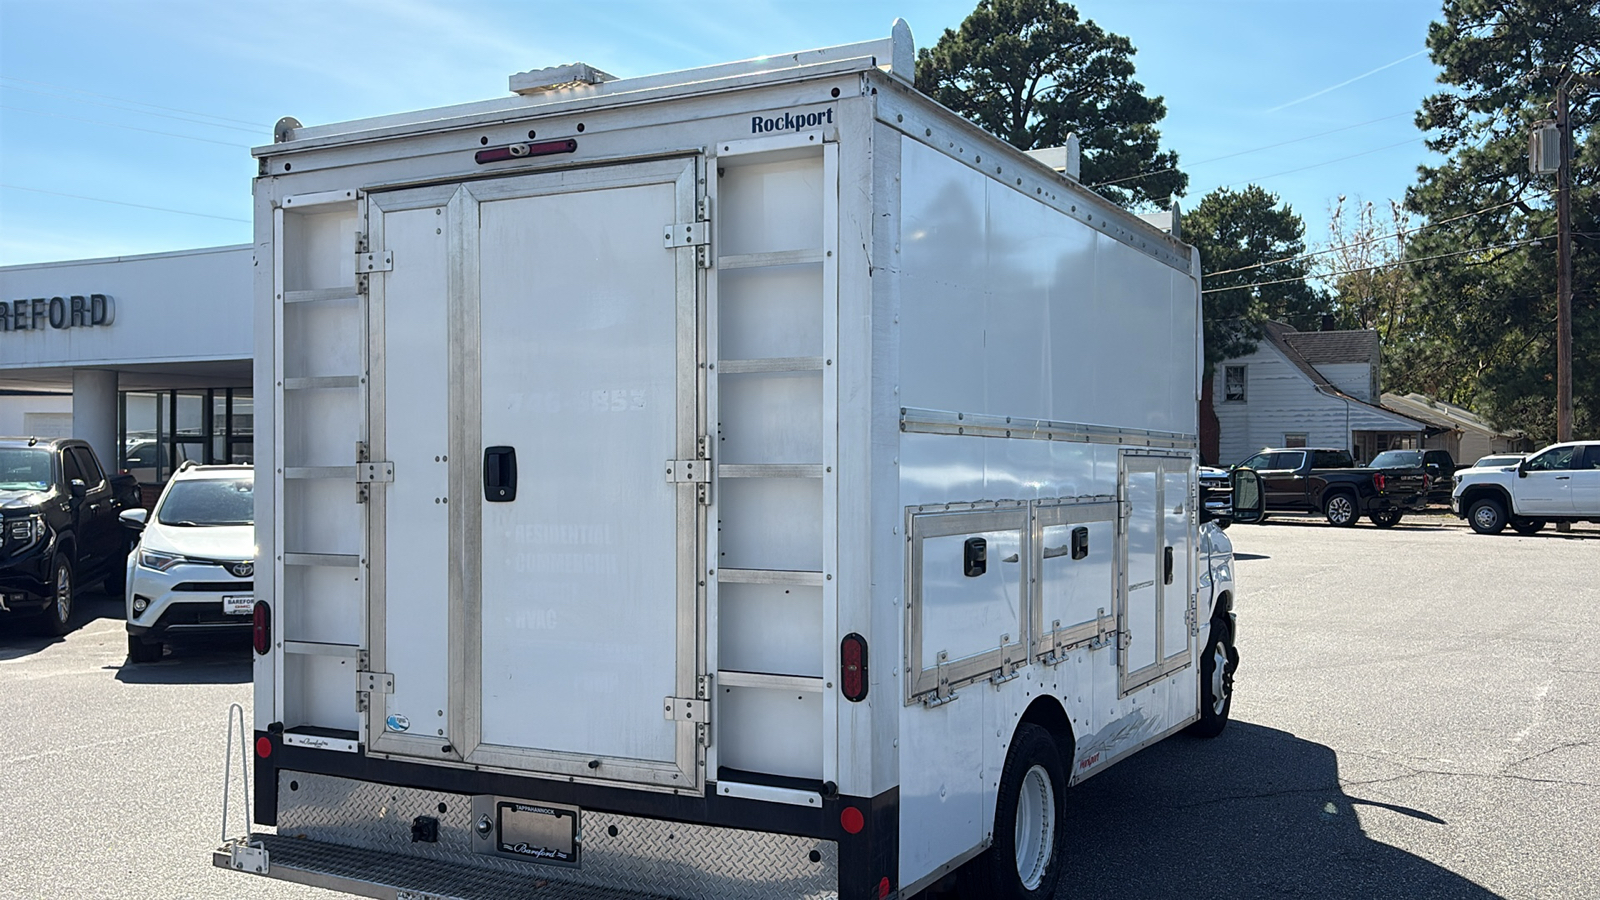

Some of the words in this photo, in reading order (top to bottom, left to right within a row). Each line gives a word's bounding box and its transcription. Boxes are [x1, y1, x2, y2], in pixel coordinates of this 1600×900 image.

[751, 107, 833, 134] Rockport
[516, 805, 555, 814] TAPPAHANNOCK
[513, 843, 557, 858] Bareford
